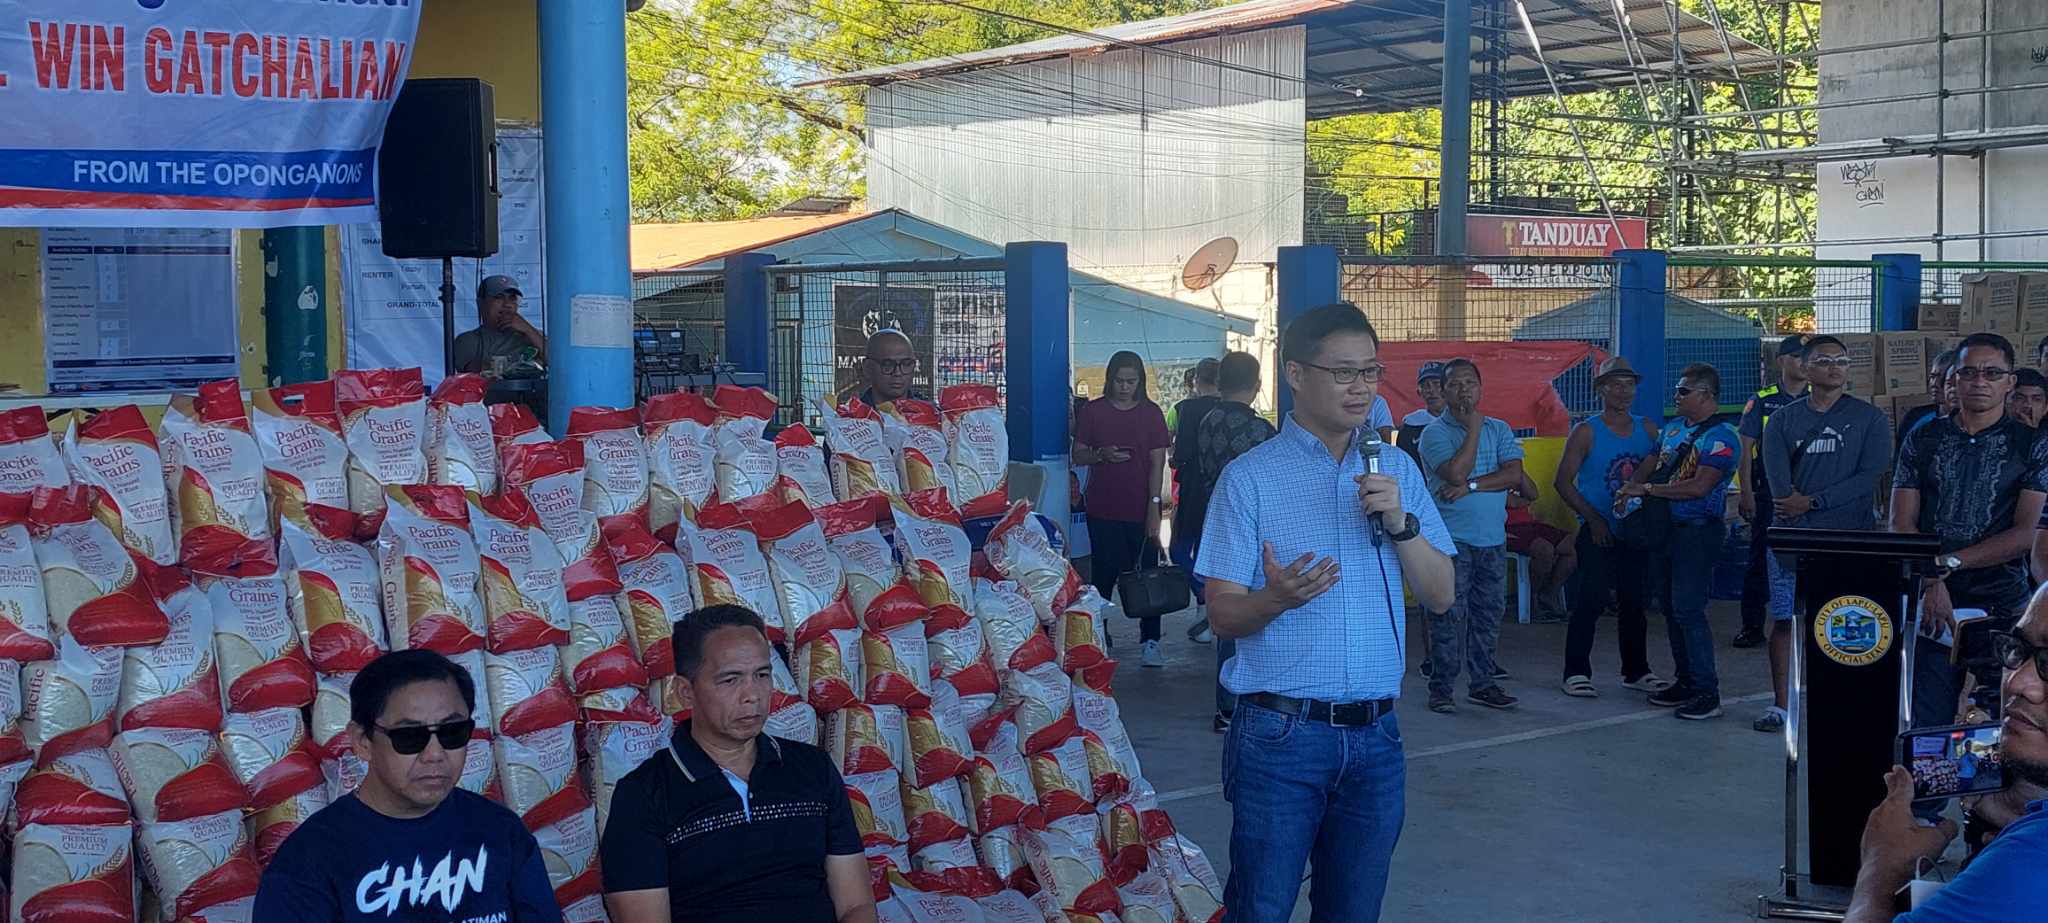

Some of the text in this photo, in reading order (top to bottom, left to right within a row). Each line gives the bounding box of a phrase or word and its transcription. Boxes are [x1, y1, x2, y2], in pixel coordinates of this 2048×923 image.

[29, 21, 406, 100] WIN GATCHALIAN
[74, 159, 363, 186] FROM THE OPONGANONS
[1519, 221, 1612, 247] TANDUAY
[367, 418, 413, 433] Pacific
[275, 422, 320, 445] Pacific
[369, 430, 416, 445] Grains
[280, 438, 326, 458] Grains
[594, 437, 634, 449] Pacific
[0, 456, 39, 470] acific
[599, 448, 640, 463] Grains
[99, 458, 141, 480] rains
[536, 497, 576, 513] Grain
[408, 525, 454, 538] Pacific
[490, 542, 528, 555] Grain
[229, 588, 279, 603] Grains
[151, 647, 195, 657] PREMIUM
[153, 654, 194, 664] QUALITY
[23, 668, 45, 721] Pacific
[193, 822, 232, 838] QUALITY
[62, 835, 108, 844] PREMIUM
[62, 842, 107, 850] QUALITY
[356, 843, 488, 918] CHAN
